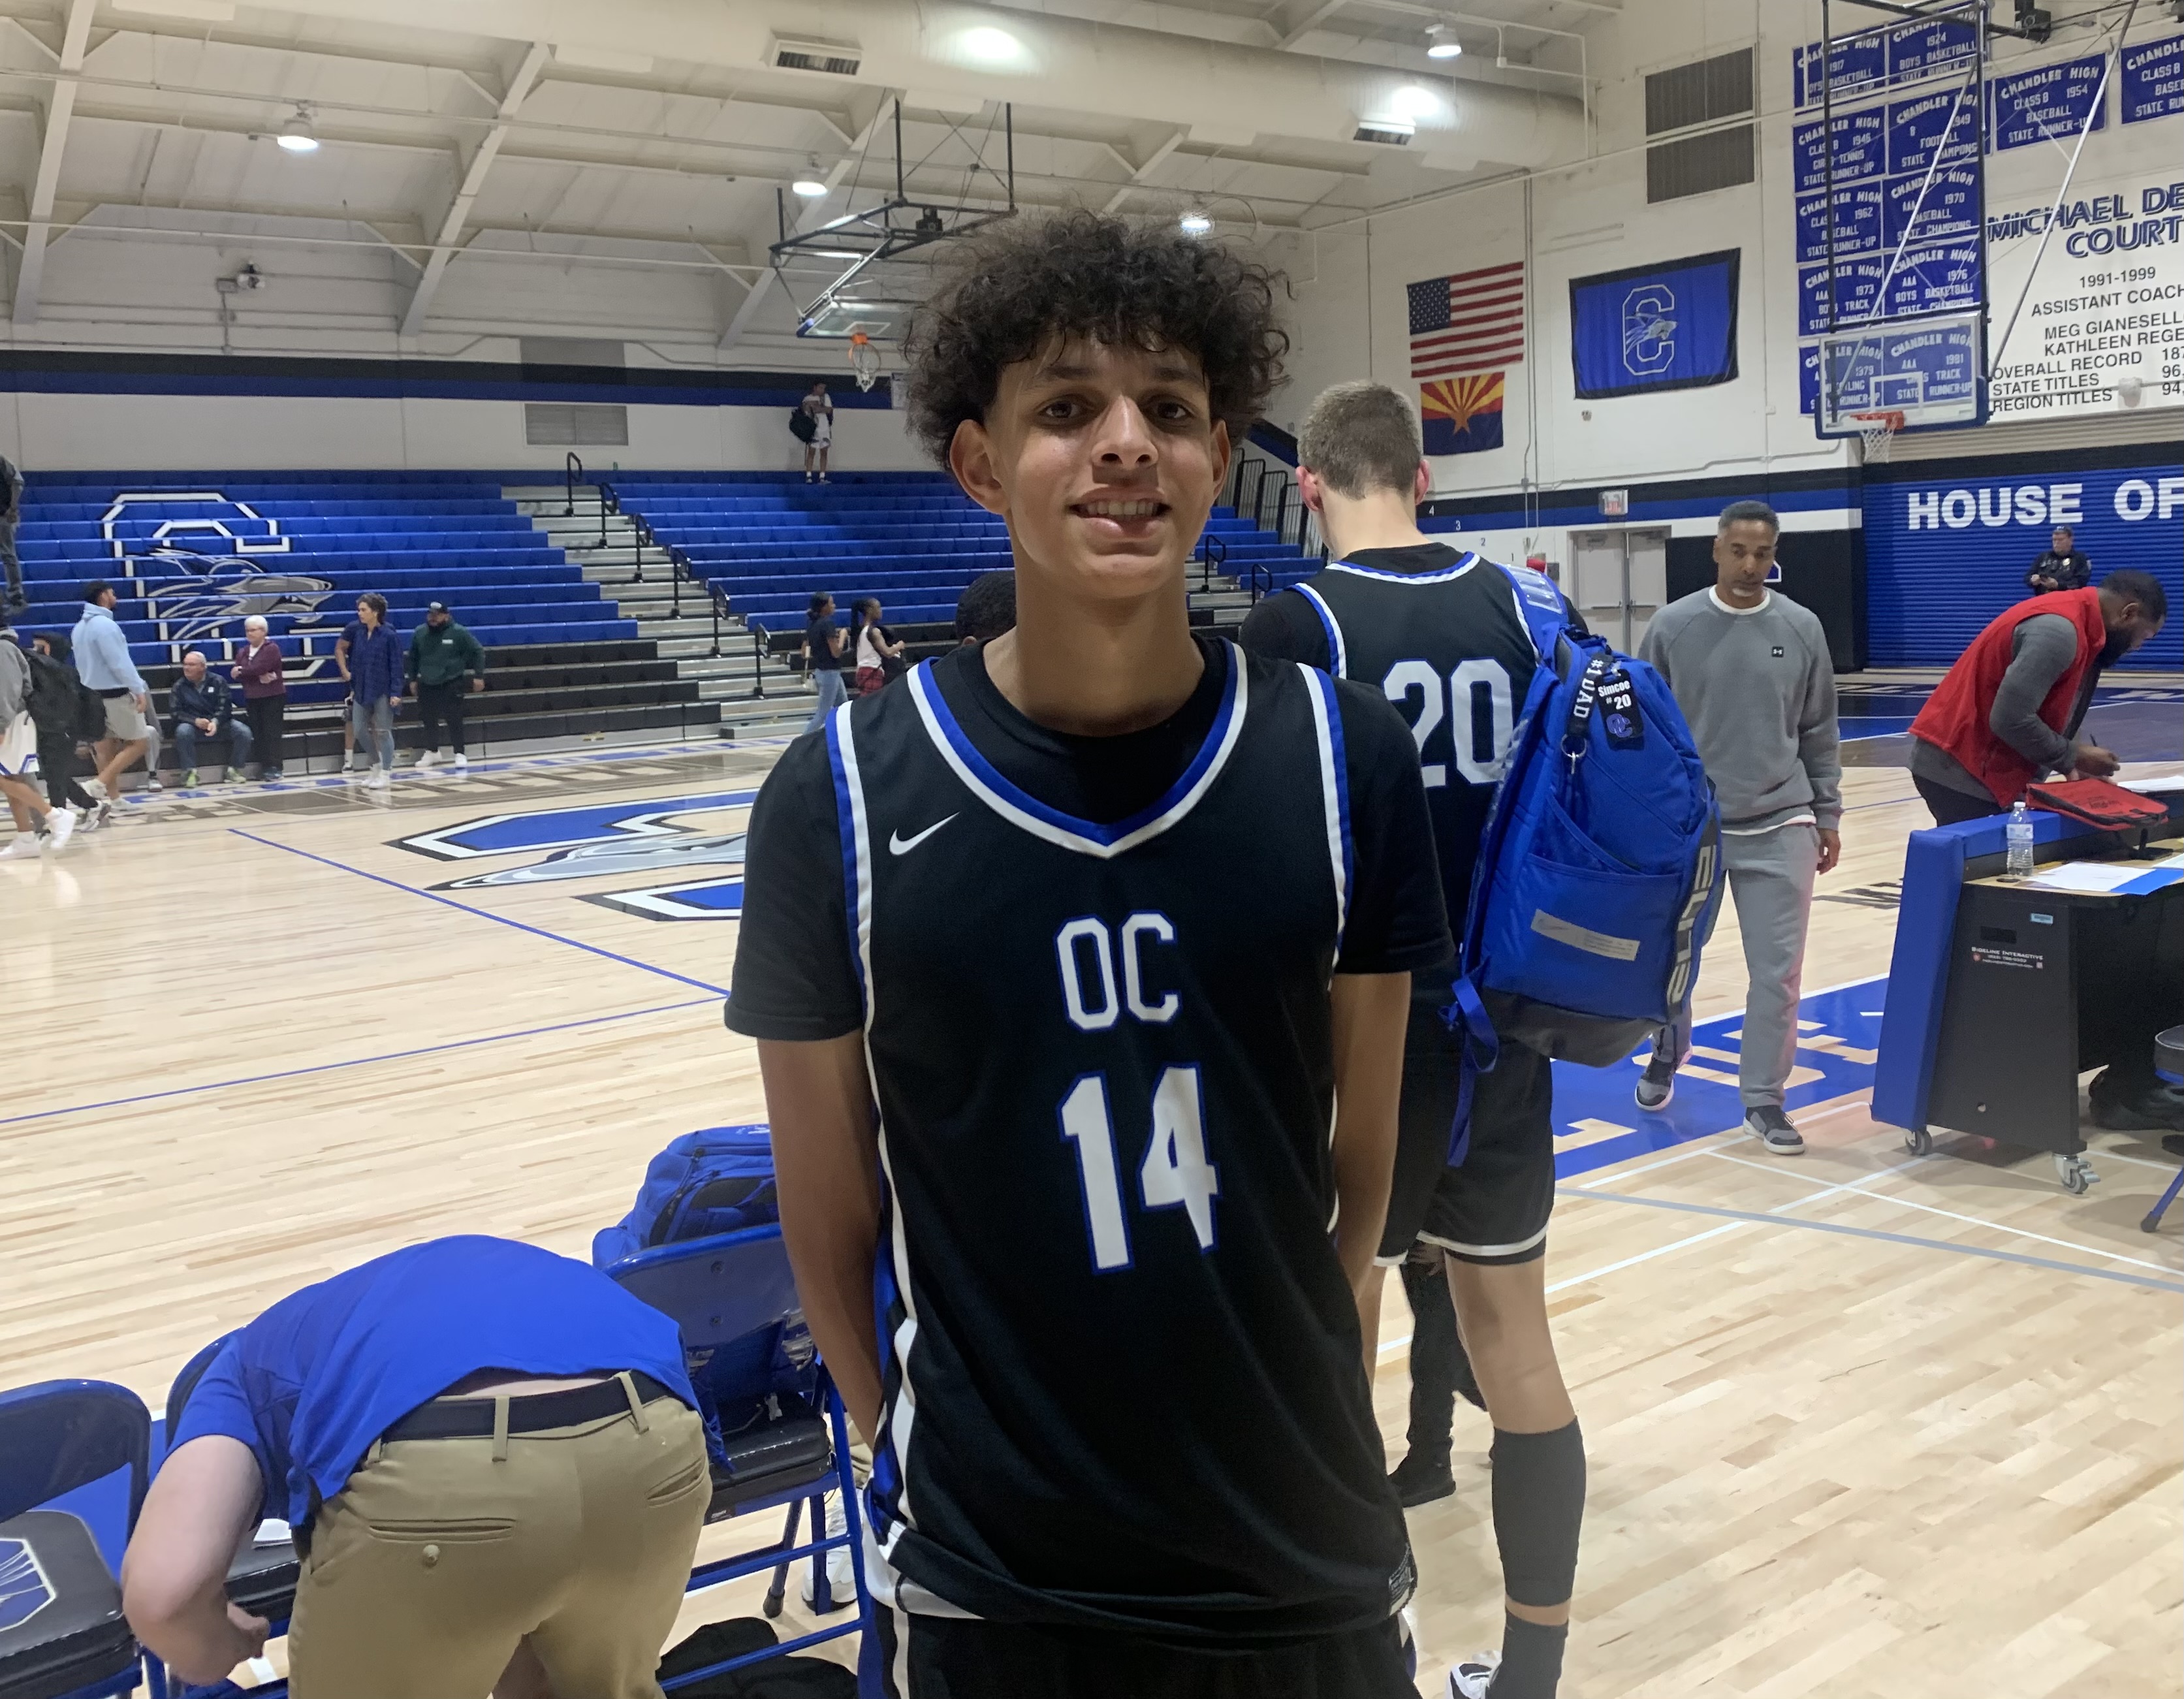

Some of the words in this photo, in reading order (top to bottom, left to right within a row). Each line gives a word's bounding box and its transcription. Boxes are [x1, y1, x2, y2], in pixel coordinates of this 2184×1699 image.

[1927, 31, 1946, 46] 1924
[1899, 56, 1921, 71] BOYS
[1927, 40, 1977, 63] BASKETBALL
[1829, 67, 1873, 88] BASKETBALL
[2142, 64, 2172, 82] CLASS
[2174, 63, 2181, 75] B
[2001, 69, 2062, 99] CHANDLER
[2070, 67, 2099, 79] HIGH
[2014, 93, 2041, 110] CLASS
[2042, 91, 2049, 103] B
[2066, 84, 2088, 99] 1954
[1896, 95, 1949, 124] CHANDLER
[2026, 104, 2072, 123] BASEBALL
[2136, 101, 2164, 118] STATE
[1856, 117, 1880, 129] HIGH
[1910, 126, 1916, 136] B
[1952, 114, 1971, 127] 949
[1833, 139, 1839, 150] B
[2008, 128, 2034, 144] STATE
[1839, 149, 1865, 165] TENNIS
[1901, 153, 1925, 168] STATE
[1804, 172, 1827, 186] STATE
[1948, 171, 1975, 187] HIGH
[1856, 191, 1882, 204] HIGH
[1944, 192, 1965, 205] 1970
[1835, 212, 1840, 223] A
[1855, 206, 1874, 220] 1962
[1986, 194, 2134, 243] MICHAEL
[1927, 220, 1972, 235] CHAMPIONS
[2066, 215, 2183, 259] COURT
[1807, 244, 1829, 257] STATE
[1833, 236, 1876, 253] RUNNER-UP
[1894, 249, 1944, 274] CHANDLER
[1950, 249, 1978, 264] HIGH
[1858, 264, 1882, 278] HIGH
[1903, 276, 1917, 287] AAA
[1948, 269, 1968, 282] 1976
[2080, 266, 2156, 288] 1991-1999
[1856, 283, 1875, 296] 1973
[1895, 290, 1917, 303] BOYS
[1925, 283, 1974, 299] BASKETBALL
[1844, 298, 1870, 312] TRACK
[2031, 292, 2122, 317] ASSISTANT
[2044, 323, 2080, 340] MEG
[1891, 333, 1943, 358] CHANDLER
[2044, 334, 2131, 357] KATHLEEN
[1901, 358, 1917, 370] AAA
[1993, 358, 2066, 380] OVERALL
[2071, 351, 2142, 372] RECORD
[1936, 368, 1962, 381] TRACK
[1929, 381, 1972, 397] RUNNER-UP
[1993, 380, 2041, 396] STATE
[2044, 373, 2100, 390] TITLES
[1993, 394, 2053, 413] REGION
[2056, 387, 2112, 406] TITLES
[1429, 505, 1435, 516] 4
[1908, 483, 2083, 530] HOUSE
[2113, 477, 2184, 522] OF
[1455, 520, 1461, 532] 3
[1481, 537, 1486, 547] 2
[1598, 680, 1630, 697] Simcoe
[1613, 693, 1632, 710] 20
[1383, 658, 1514, 787] 20
[1055, 910, 1182, 1032] OC
[1057, 1062, 1222, 1275] 14
